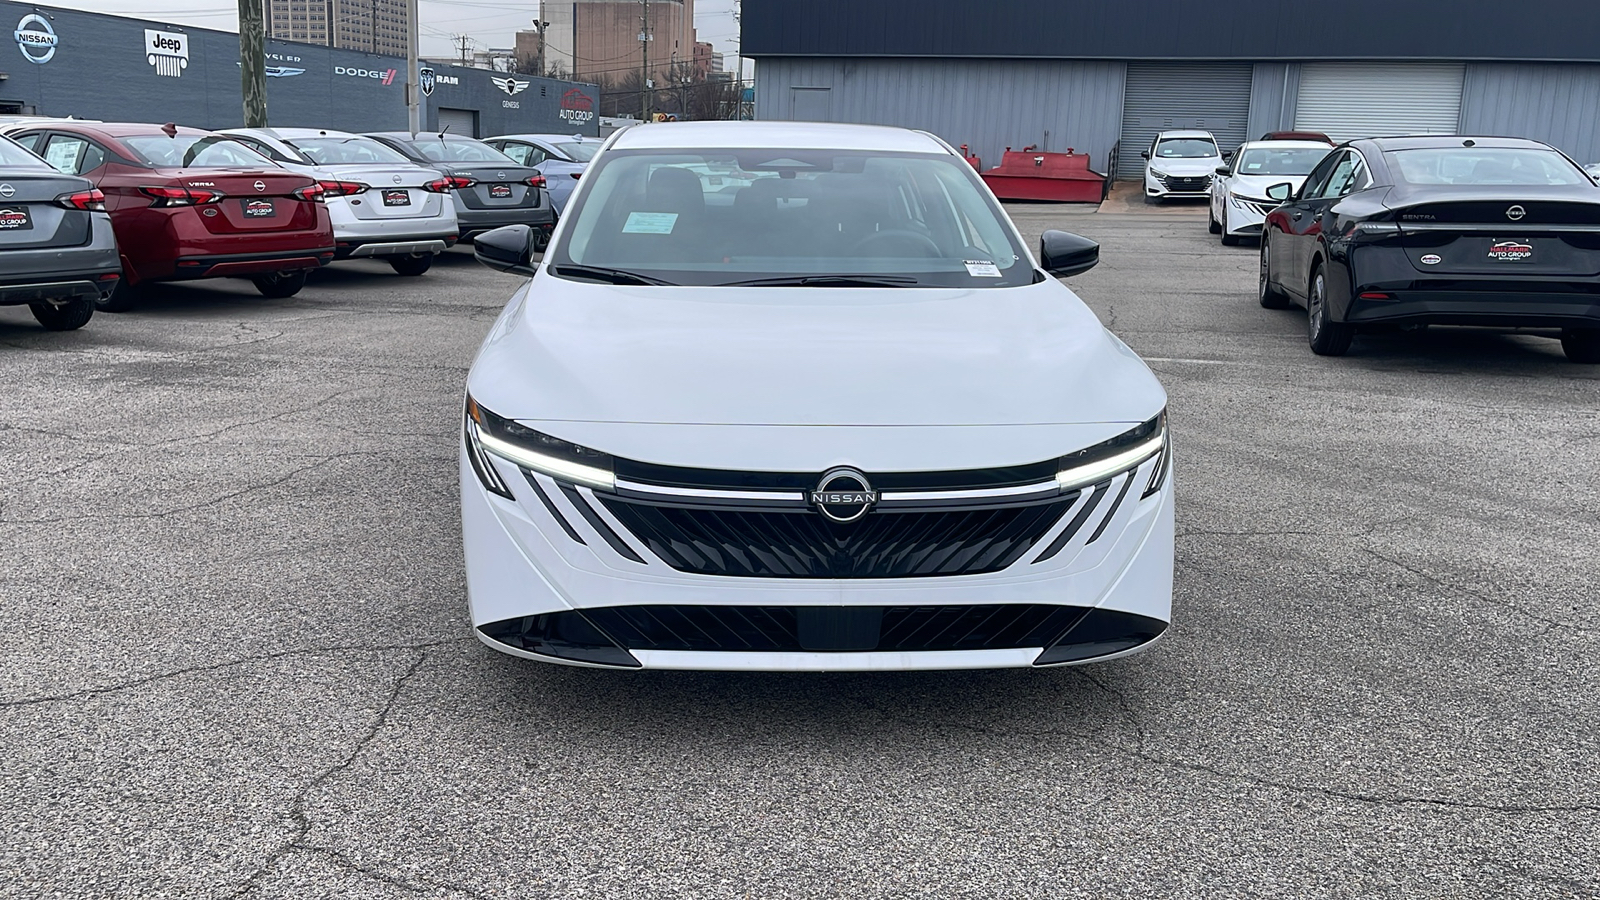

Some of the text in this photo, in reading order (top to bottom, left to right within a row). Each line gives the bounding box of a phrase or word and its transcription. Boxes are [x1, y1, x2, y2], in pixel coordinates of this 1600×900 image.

[18, 33, 54, 45] NISSAN
[152, 33, 181, 53] Jeep
[265, 53, 301, 62] YSLER
[334, 66, 389, 80] DODGE
[436, 75, 459, 85] RAM
[502, 100, 520, 109] GENESIS
[559, 109, 593, 121] AUTO GROUP
[812, 494, 875, 503] NISSAN
